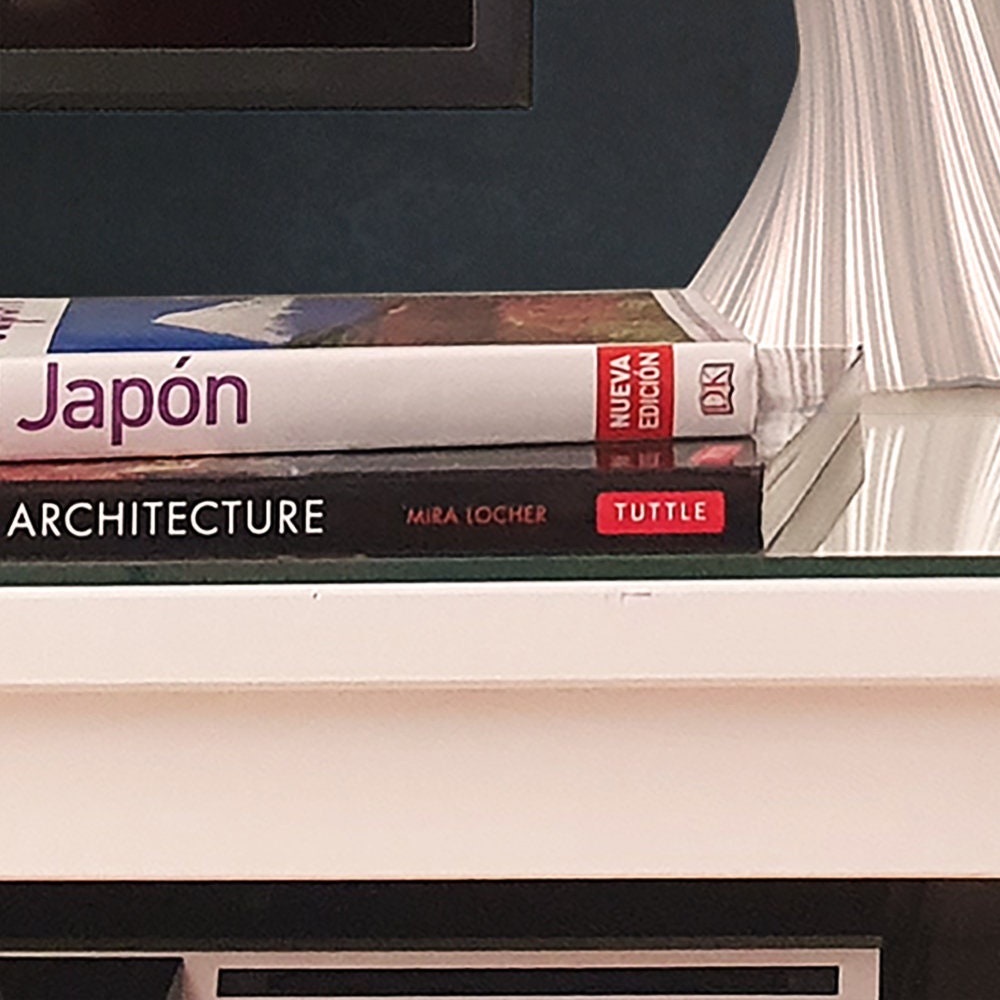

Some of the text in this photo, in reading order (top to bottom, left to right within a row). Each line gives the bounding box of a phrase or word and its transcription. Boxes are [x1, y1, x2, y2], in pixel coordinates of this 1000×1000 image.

[17, 356, 249, 446] Japón
[609, 354, 632, 429] NUEVA
[633, 352, 661, 430] EDICIÓN
[702, 365, 731, 413] DK
[7, 500, 325, 538] ARCHITECTURE
[406, 505, 548, 525] MIRA LOCHER
[614, 502, 708, 522] TUTTLE
